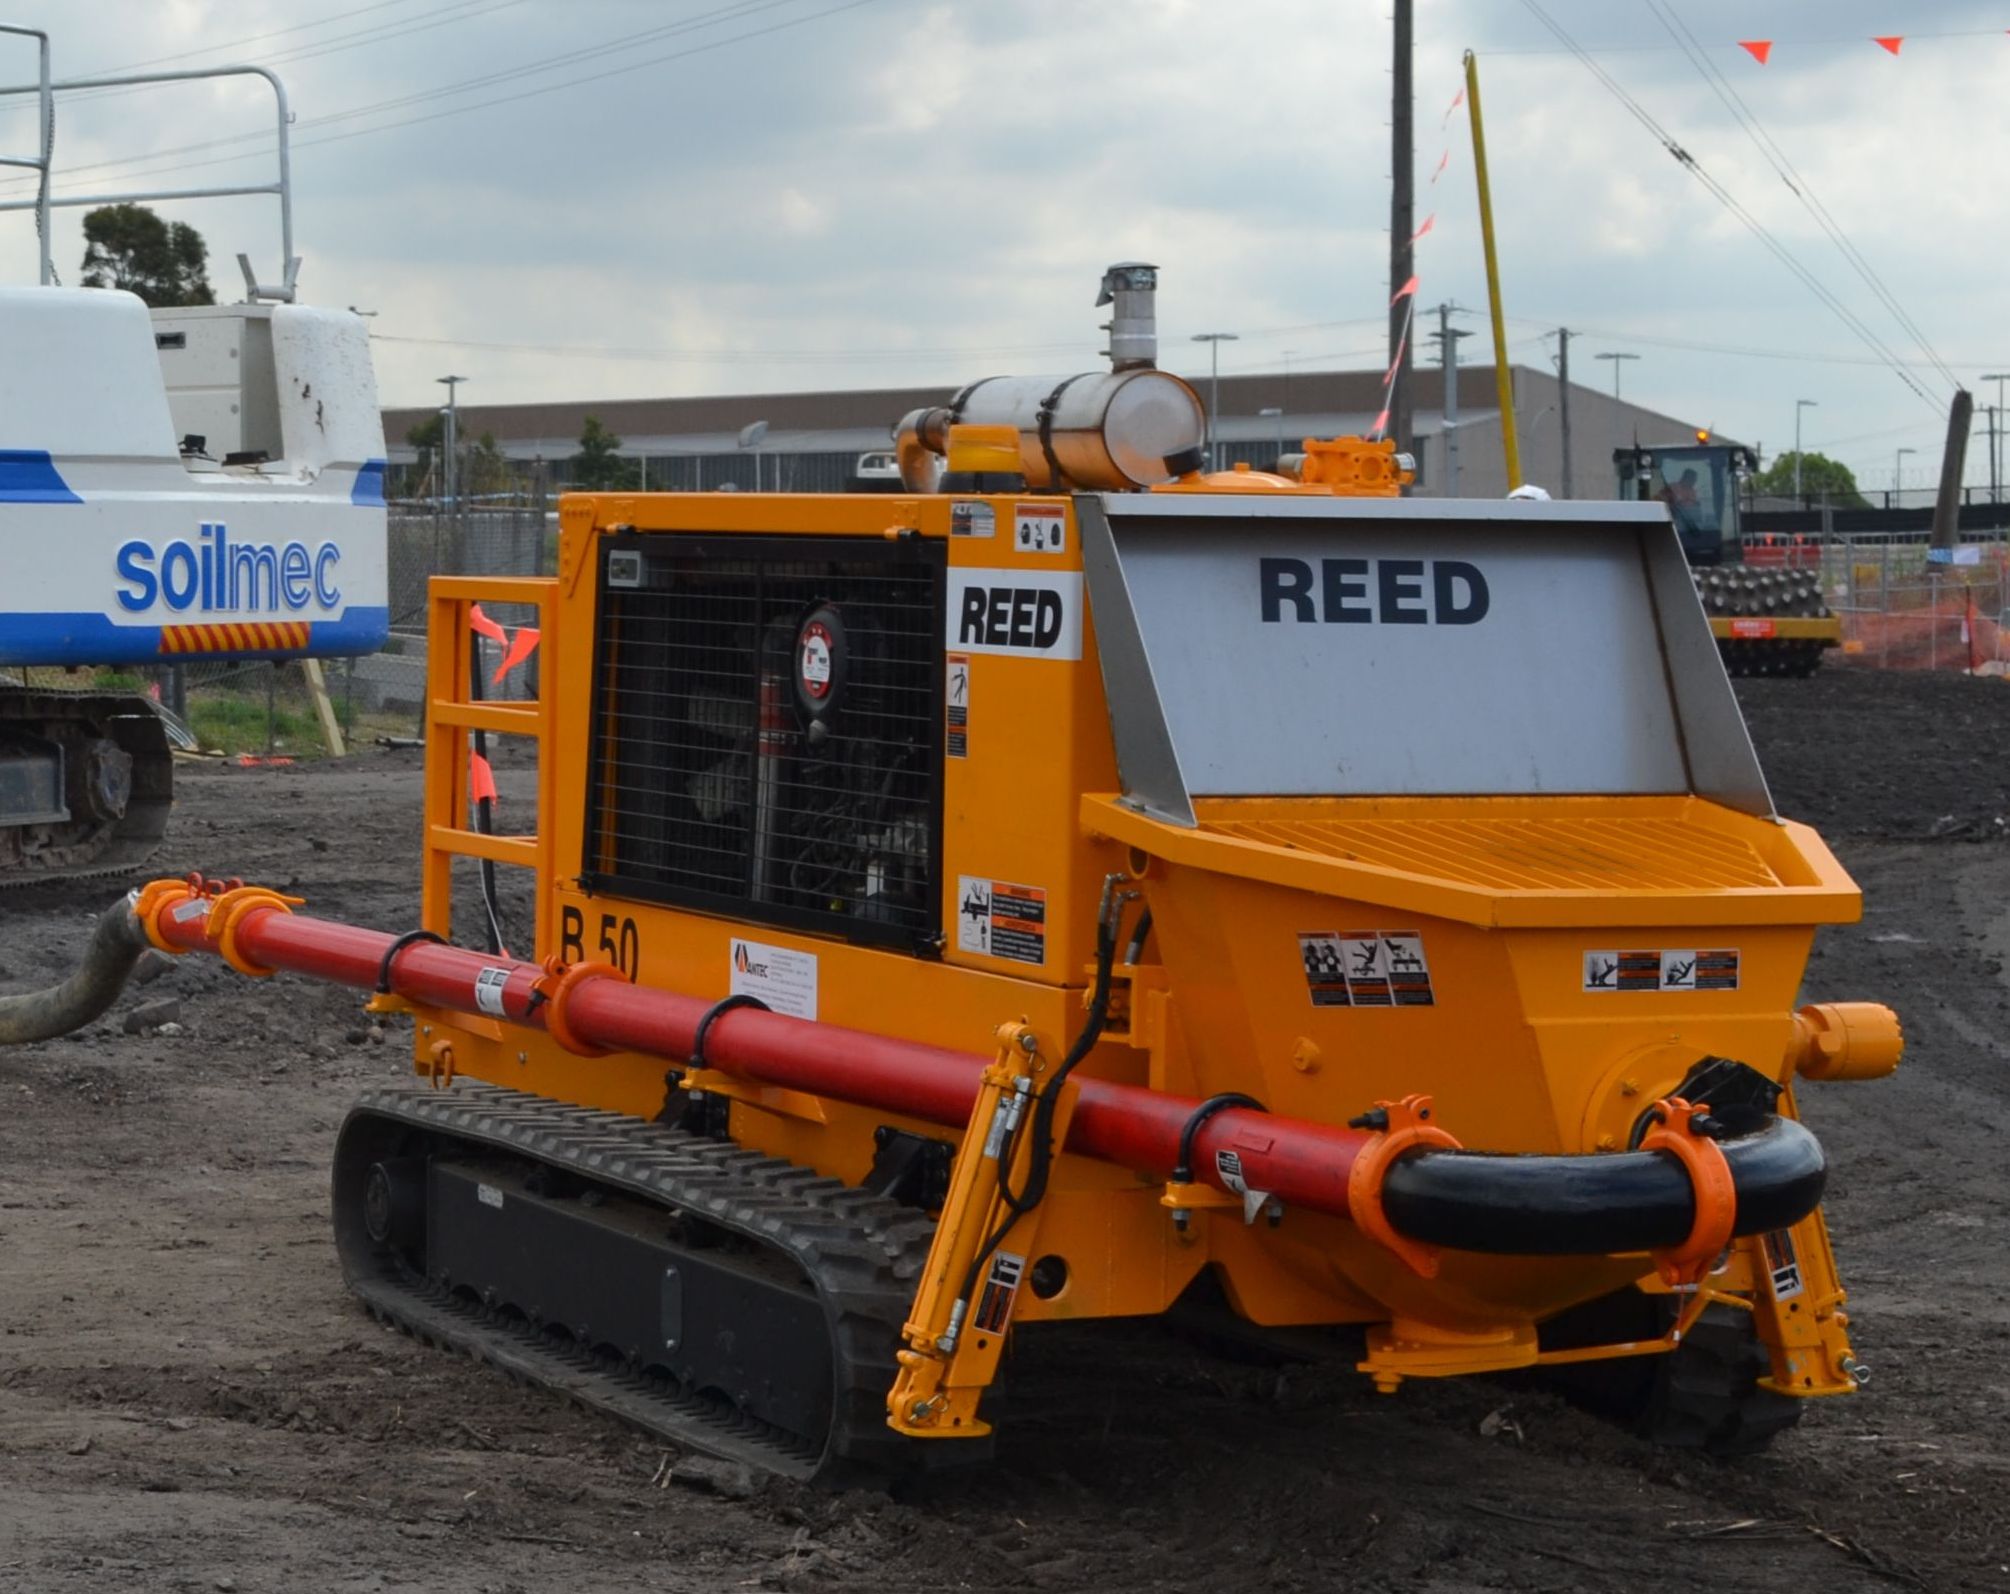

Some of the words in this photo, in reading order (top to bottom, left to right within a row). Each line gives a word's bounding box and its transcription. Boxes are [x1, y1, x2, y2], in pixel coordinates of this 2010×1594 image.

[115, 522, 341, 612] soilmec
[1260, 557, 1489, 625] REED
[959, 586, 1063, 648] REED
[599, 912, 639, 985] 50
